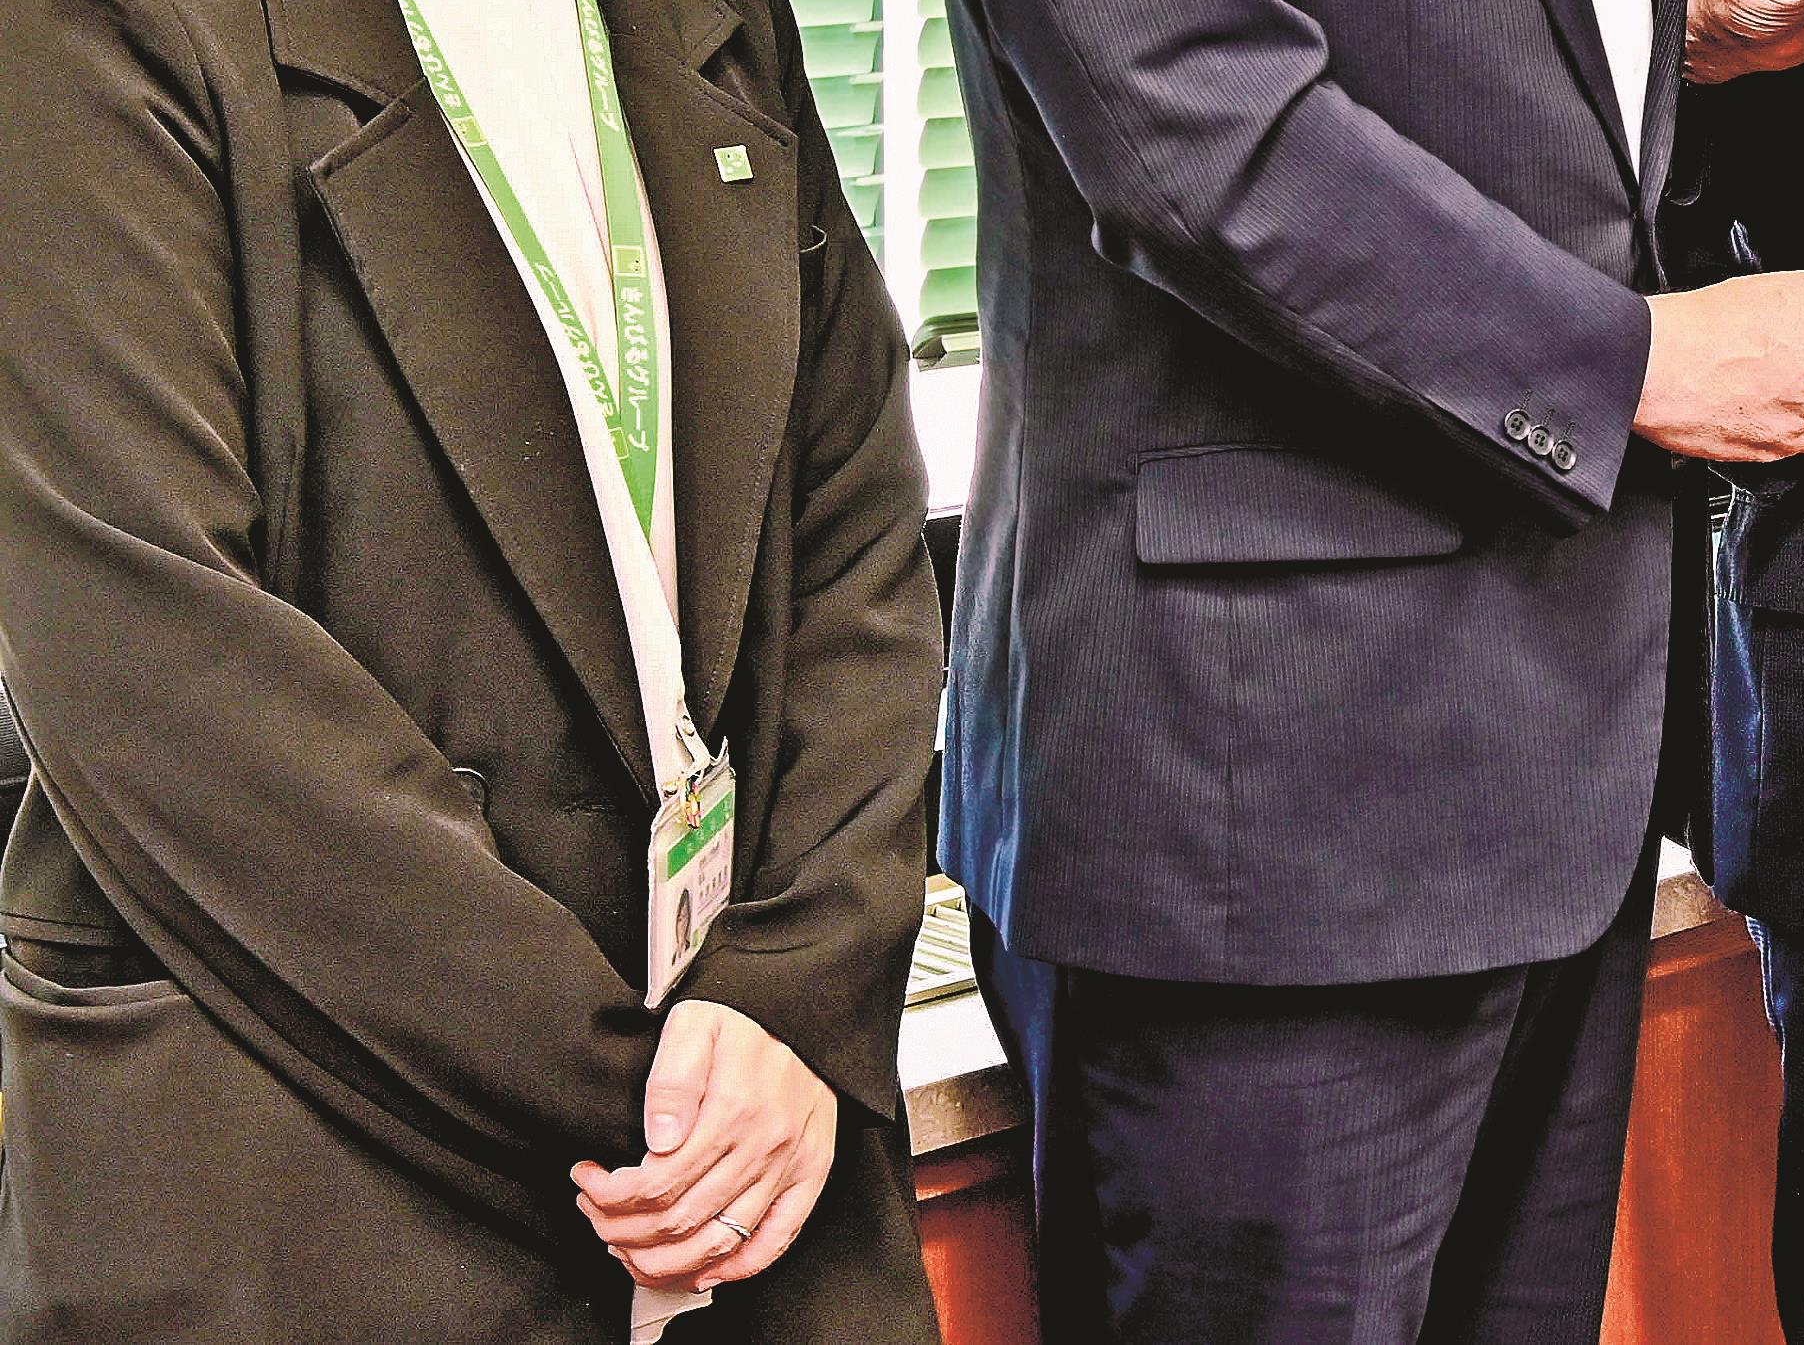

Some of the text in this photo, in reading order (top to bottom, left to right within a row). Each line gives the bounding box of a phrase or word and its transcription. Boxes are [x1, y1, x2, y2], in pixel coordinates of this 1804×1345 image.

[620, 286, 649, 452] さんびるグループ
